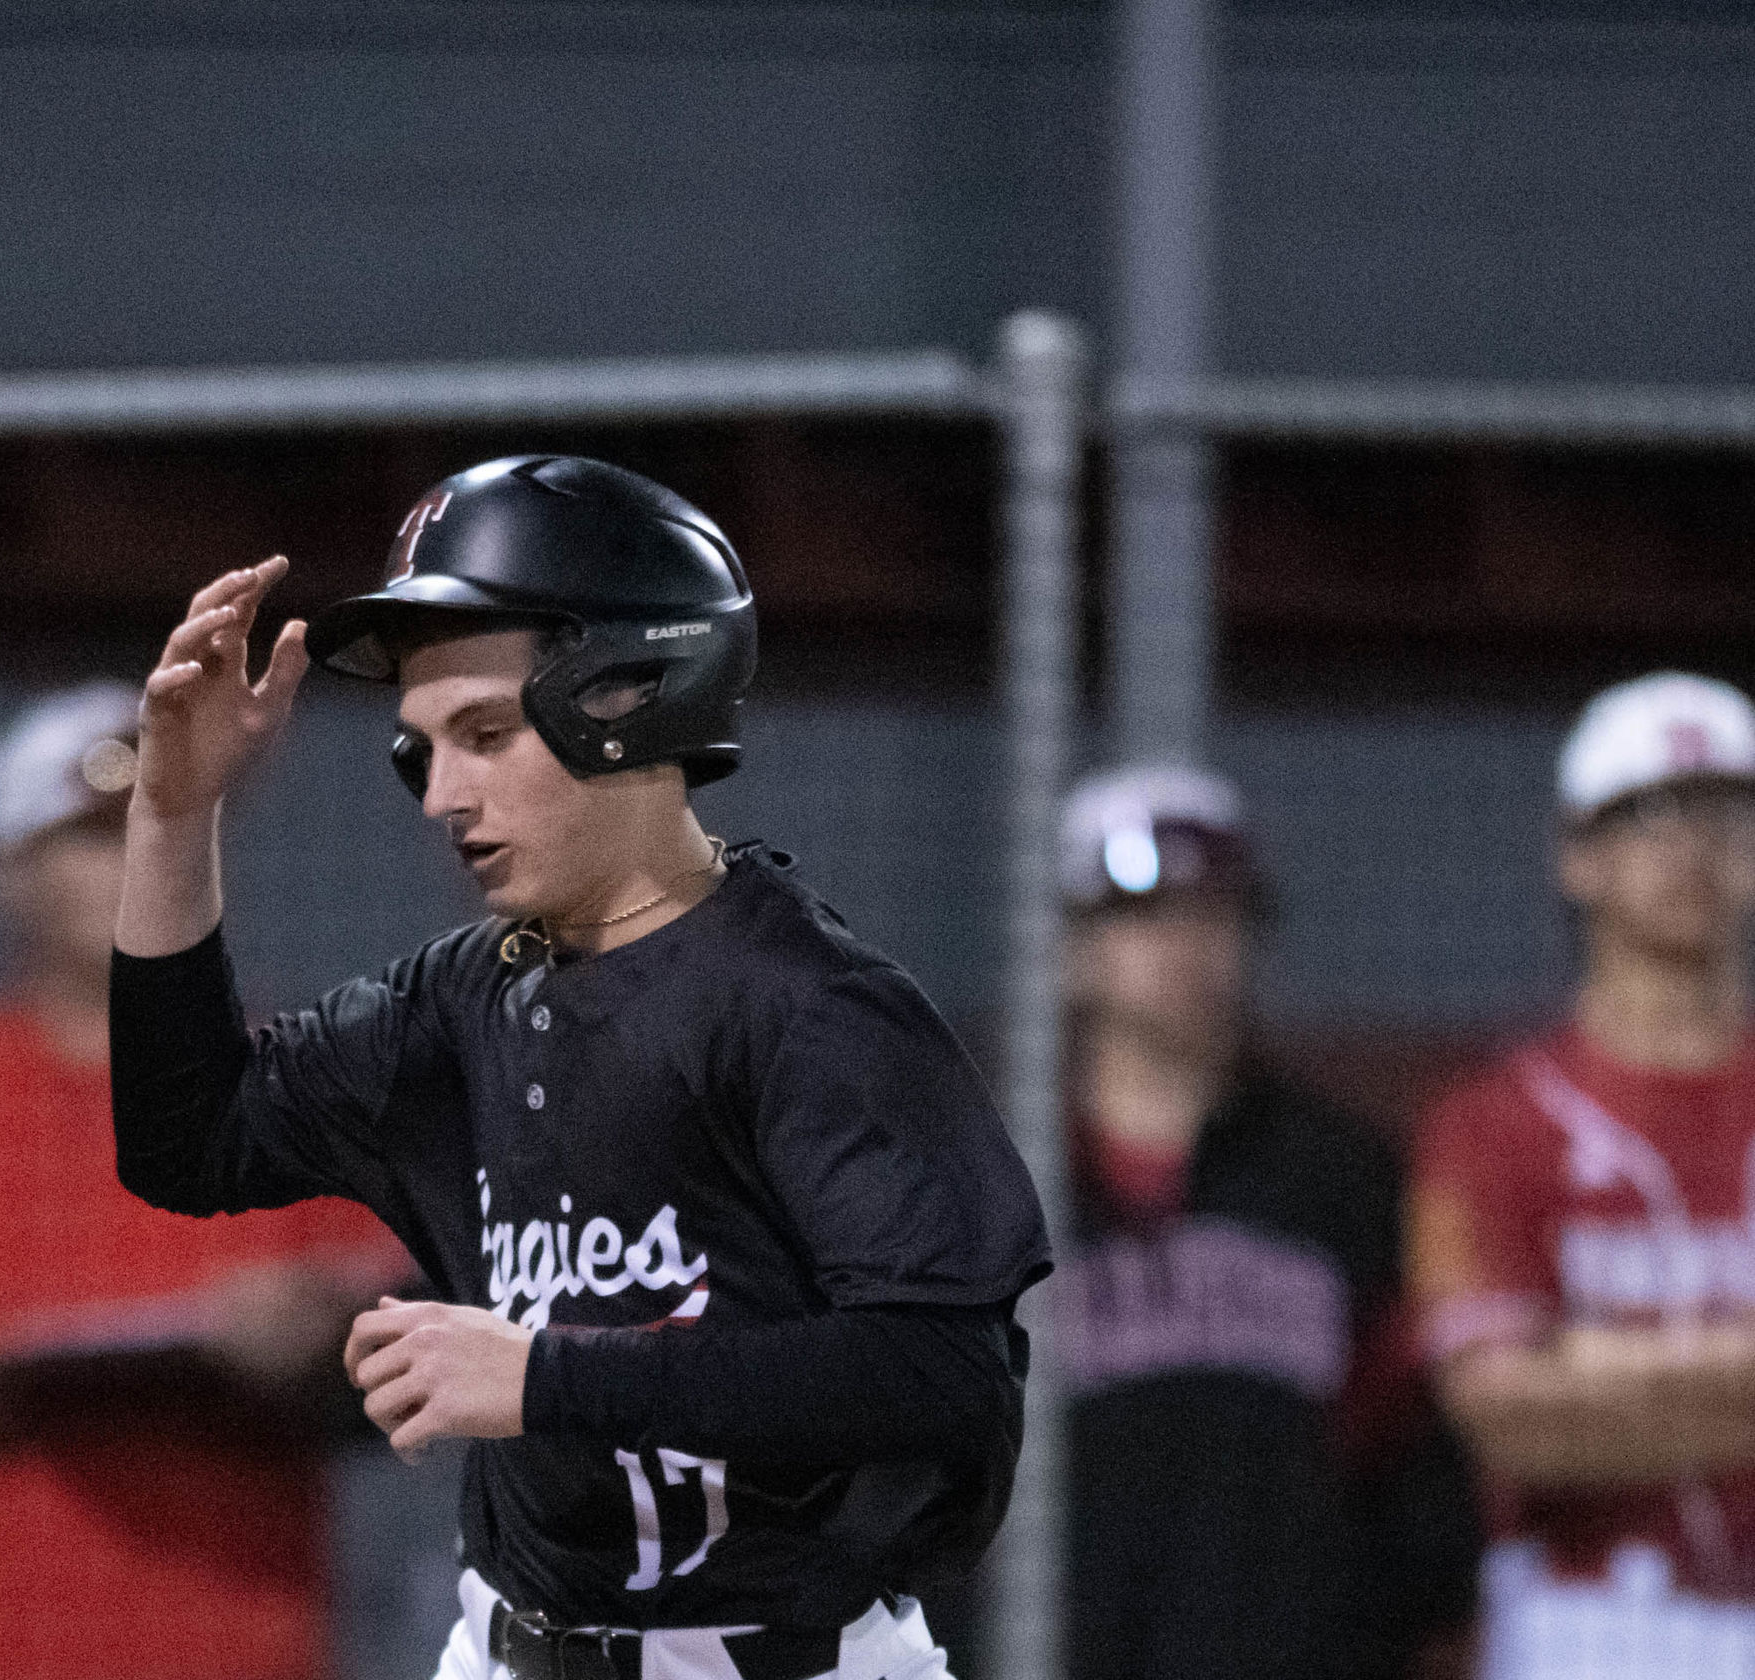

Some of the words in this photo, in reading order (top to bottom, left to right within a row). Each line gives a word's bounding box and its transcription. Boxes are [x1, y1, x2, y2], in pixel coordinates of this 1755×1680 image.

[645, 621, 713, 641] EASTON
[476, 1166, 709, 1332] ggies
[611, 1447, 730, 1591] 17
